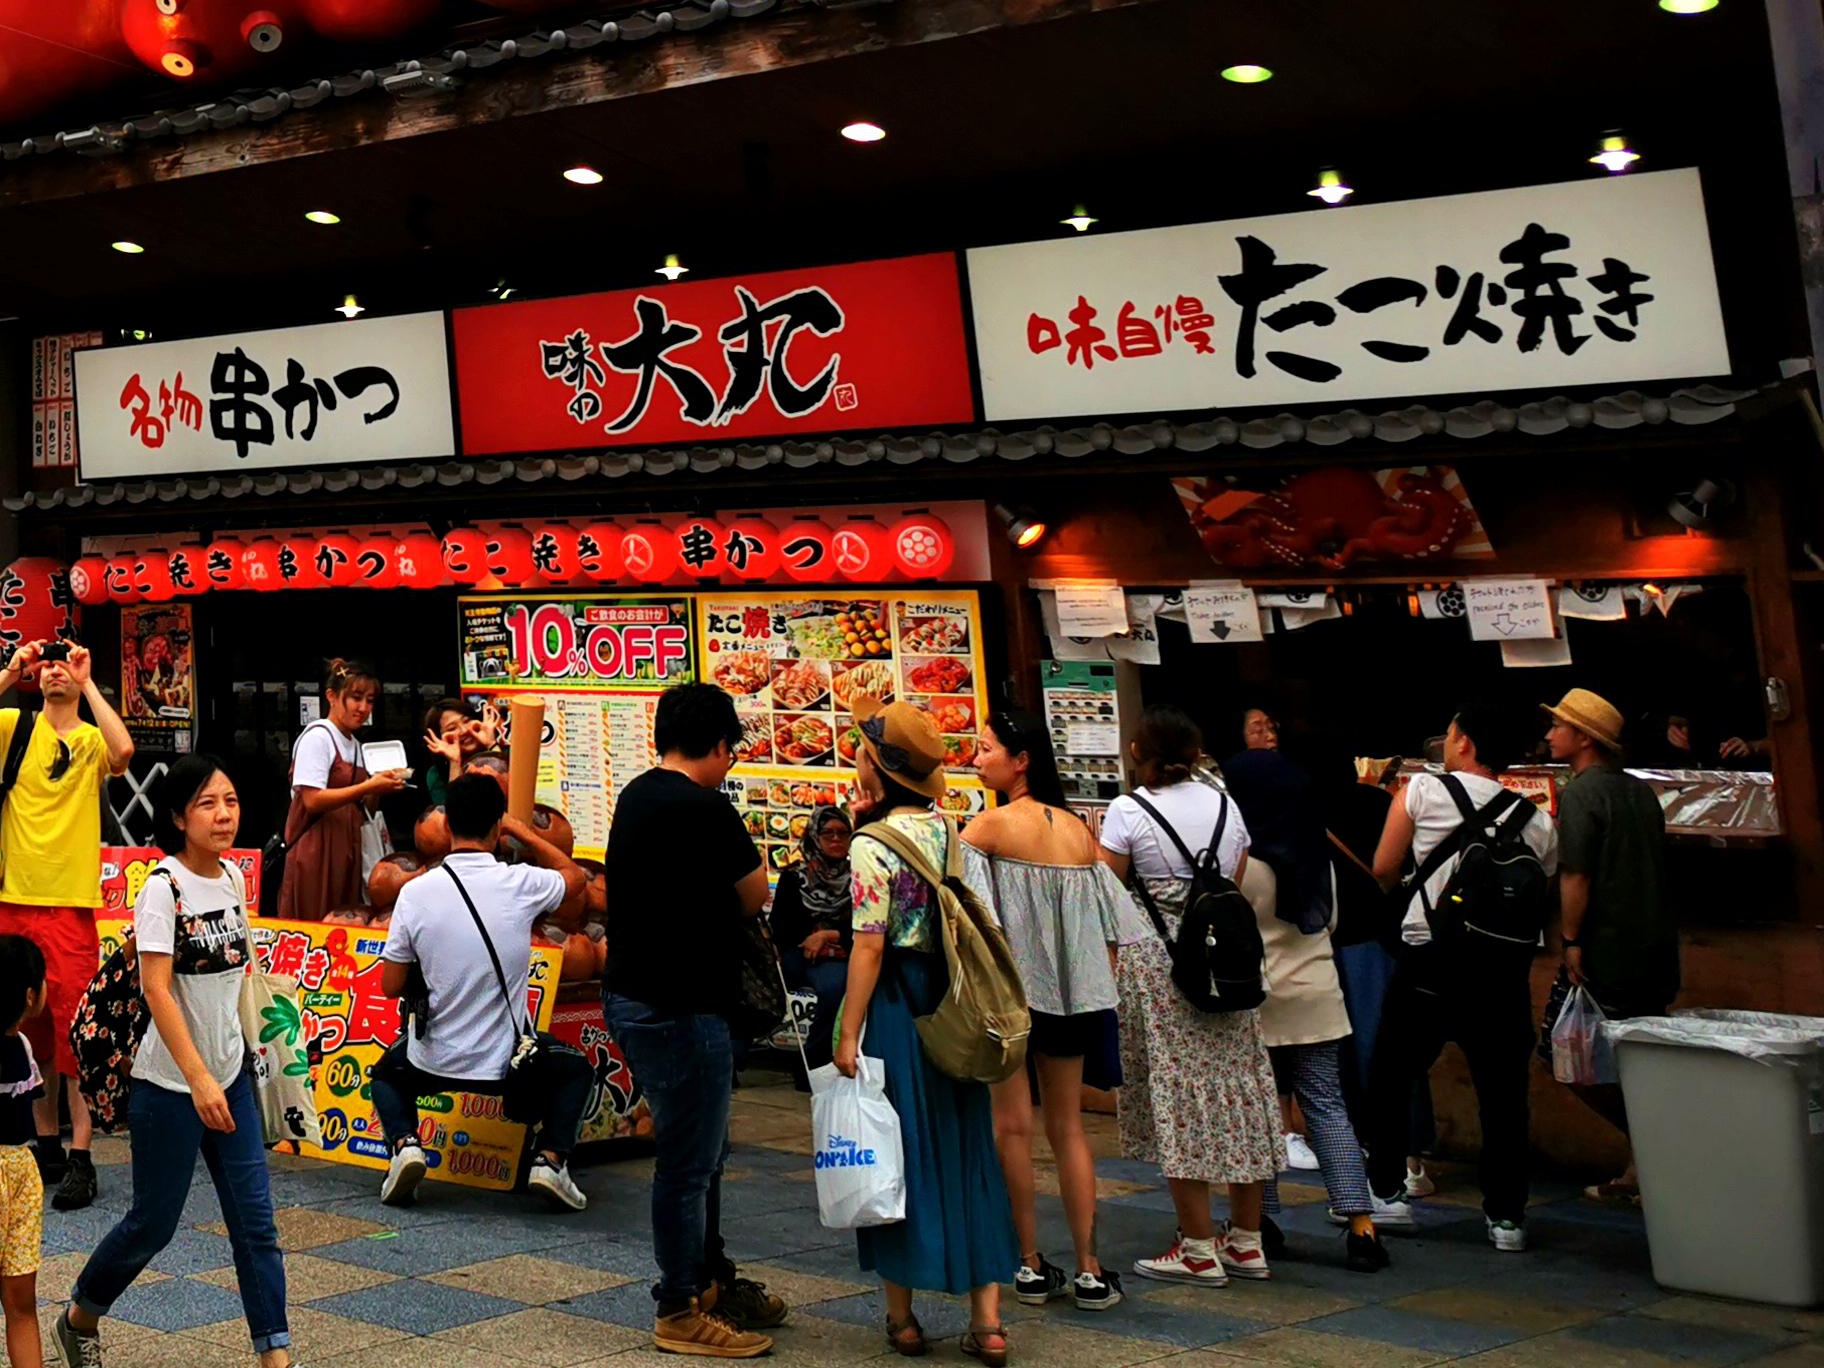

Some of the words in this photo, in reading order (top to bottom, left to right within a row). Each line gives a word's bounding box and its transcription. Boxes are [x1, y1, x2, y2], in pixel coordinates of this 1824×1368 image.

[1026, 294, 1216, 370] 味自慢
[1217, 222, 1655, 383] たこ焼き
[602, 285, 846, 434] 大丸
[119, 371, 203, 448] 名物
[209, 346, 400, 458] 串かつ
[679, 525, 825, 570] 串かつ
[707, 606, 787, 639] たこ焼き
[907, 602, 968, 615] こだわりメニュー
[586, 624, 688, 679] OFF
[304, 994, 341, 1005] パーティー
[327, 1061, 360, 1089] 60分
[847, 1148, 875, 1166] ICE
